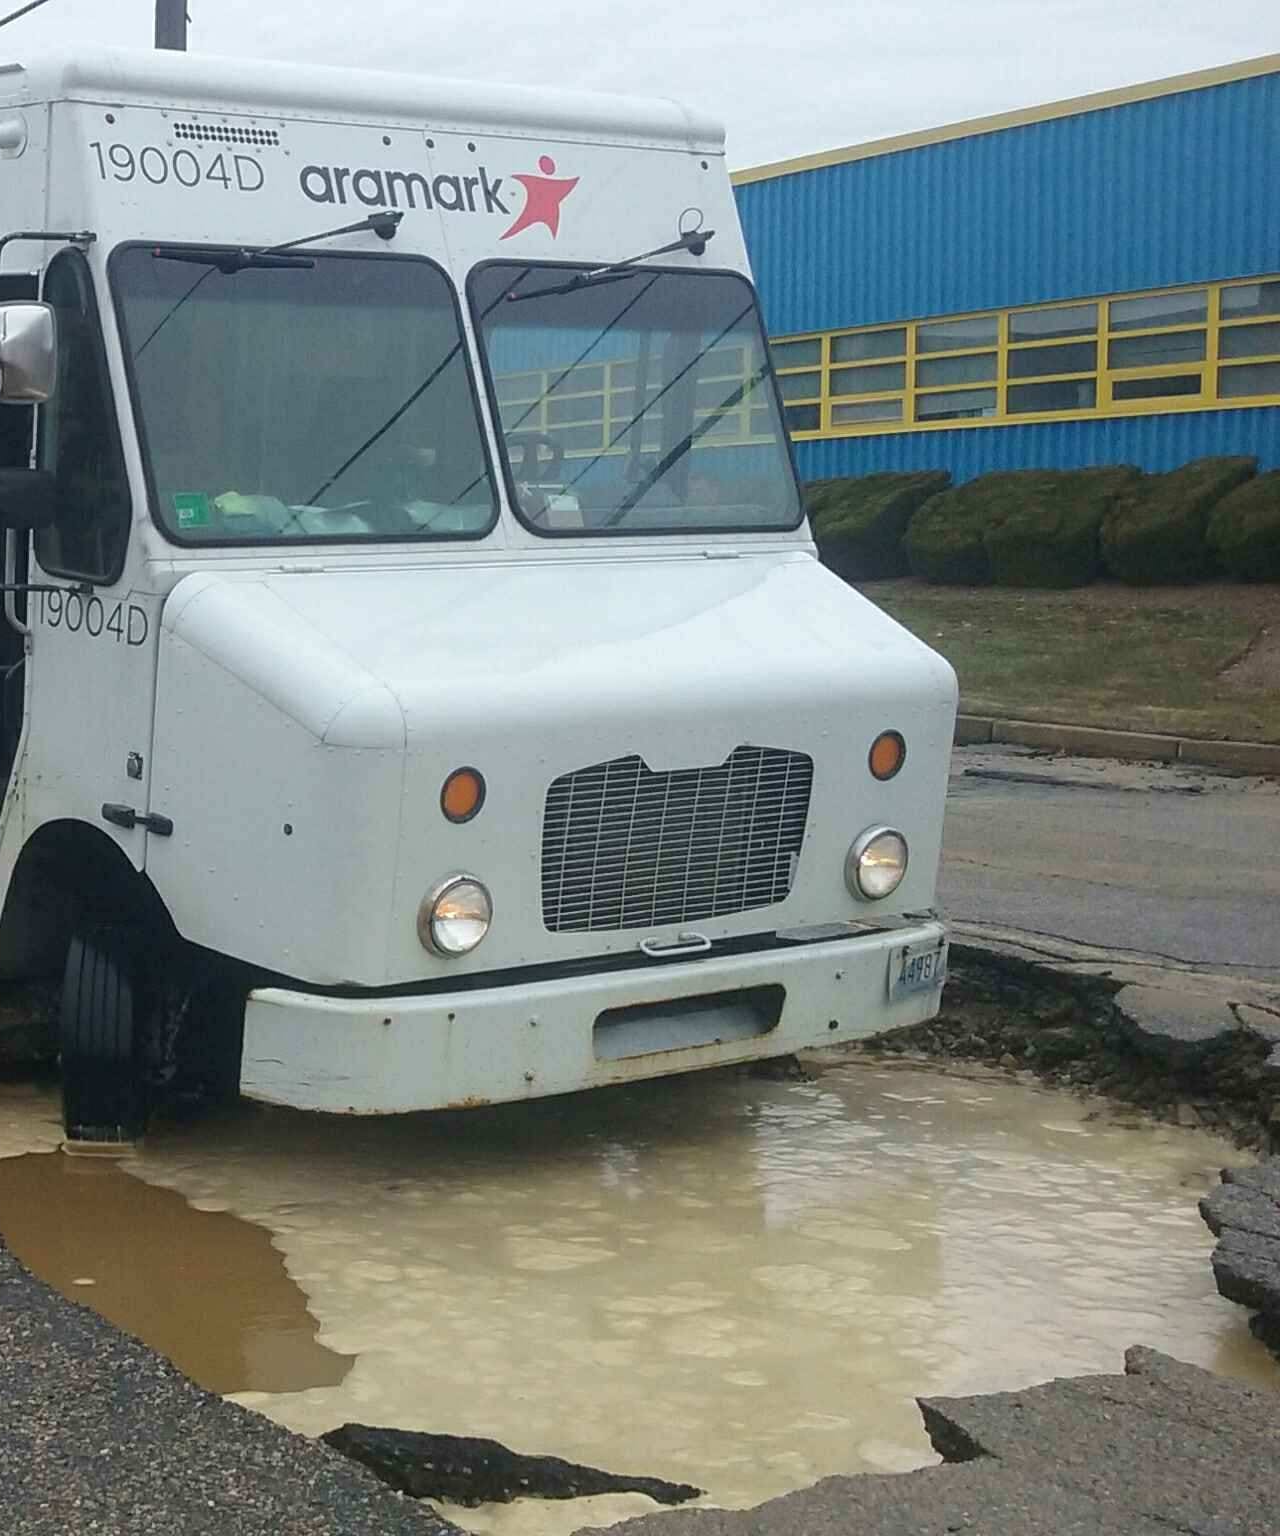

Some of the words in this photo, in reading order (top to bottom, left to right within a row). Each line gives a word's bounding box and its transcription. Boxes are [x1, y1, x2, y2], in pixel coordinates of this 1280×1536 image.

[88, 141, 266, 192] 19004D
[299, 164, 511, 215] aramark
[39, 588, 149, 646] 19004D
